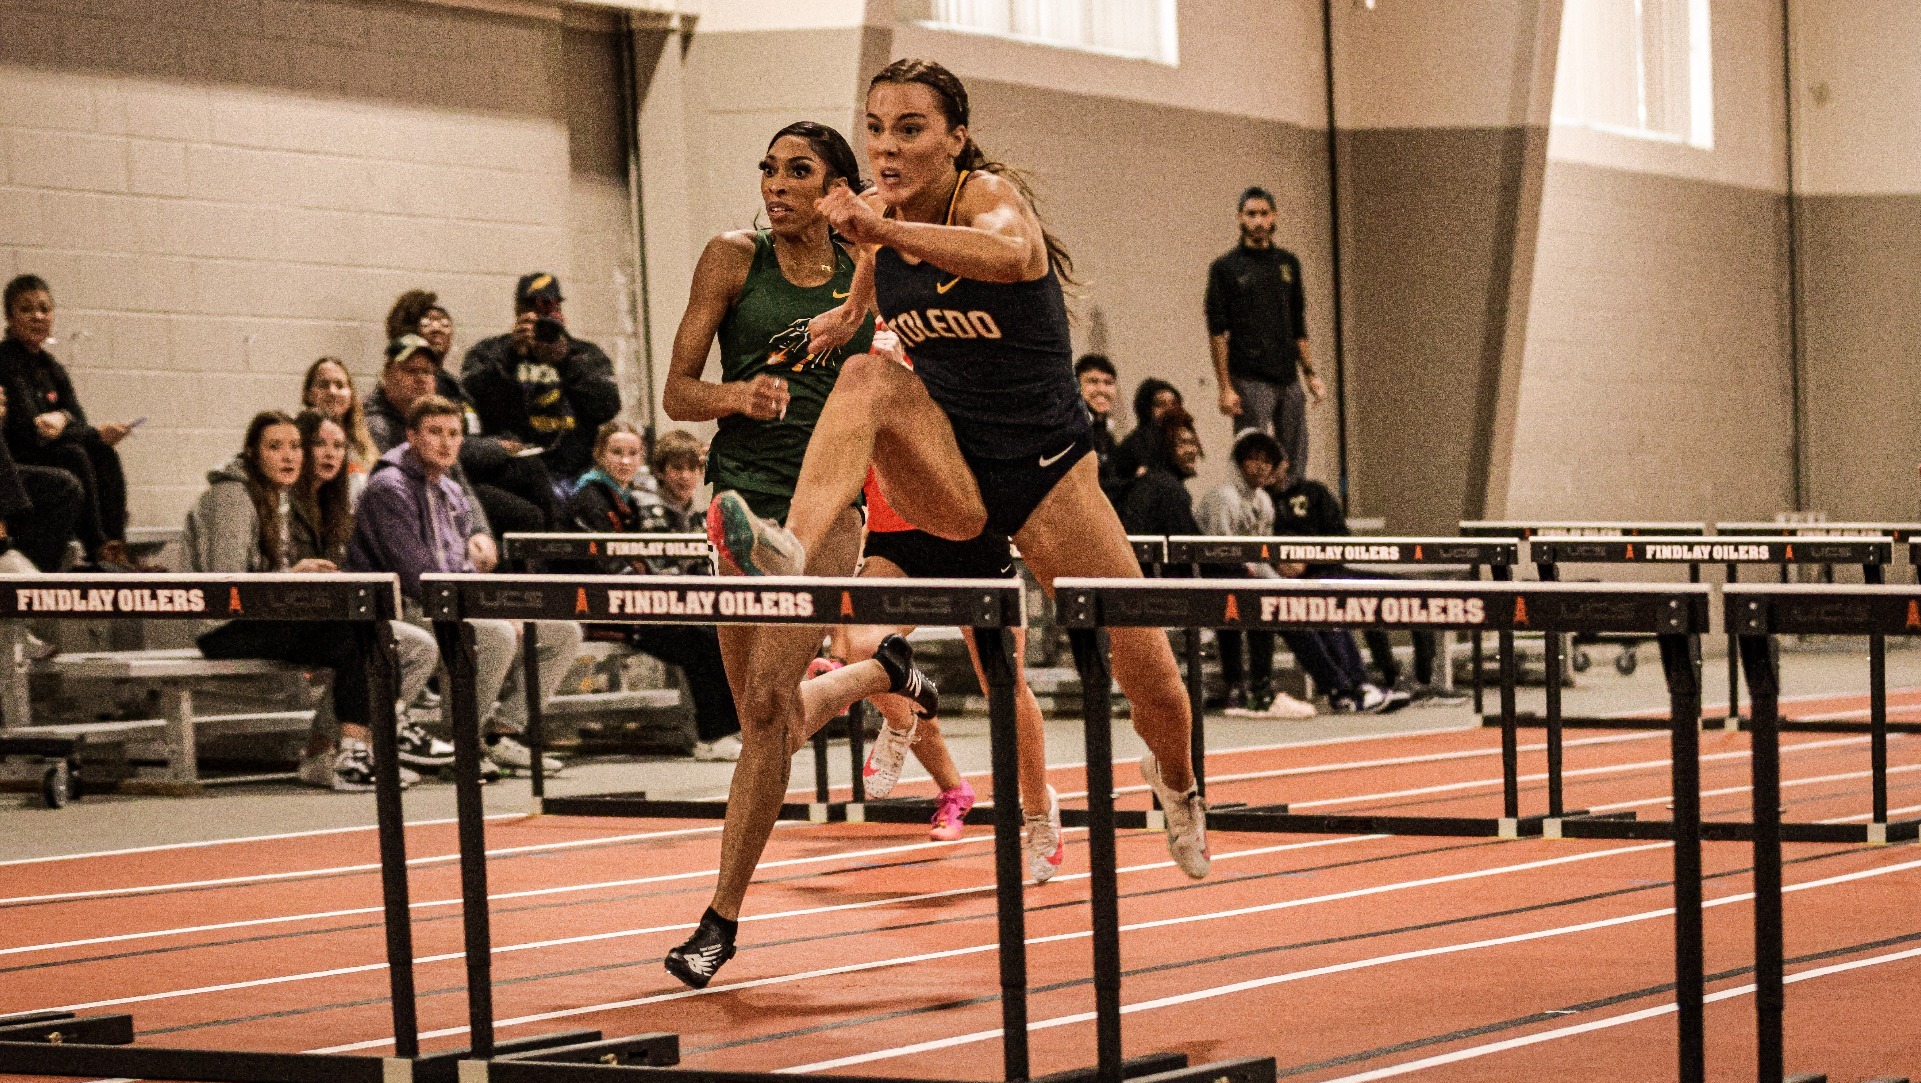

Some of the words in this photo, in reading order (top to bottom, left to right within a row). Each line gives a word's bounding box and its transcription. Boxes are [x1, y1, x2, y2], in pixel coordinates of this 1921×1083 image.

[888, 308, 1002, 348] TOLEDO
[607, 541, 664, 556] FINDLAY
[1280, 545, 1343, 560] FINDLAY
[1344, 545, 1400, 561] OILERS
[1646, 545, 1711, 559] FINDLAY
[1712, 545, 1769, 560] OILERS
[17, 588, 115, 611] FINDLAY
[117, 588, 205, 611] OILERS
[608, 590, 716, 615] FINDLAY
[718, 591, 814, 617] OILERS
[1260, 596, 1378, 622] FINDLAY
[1381, 597, 1485, 624] OILERS
